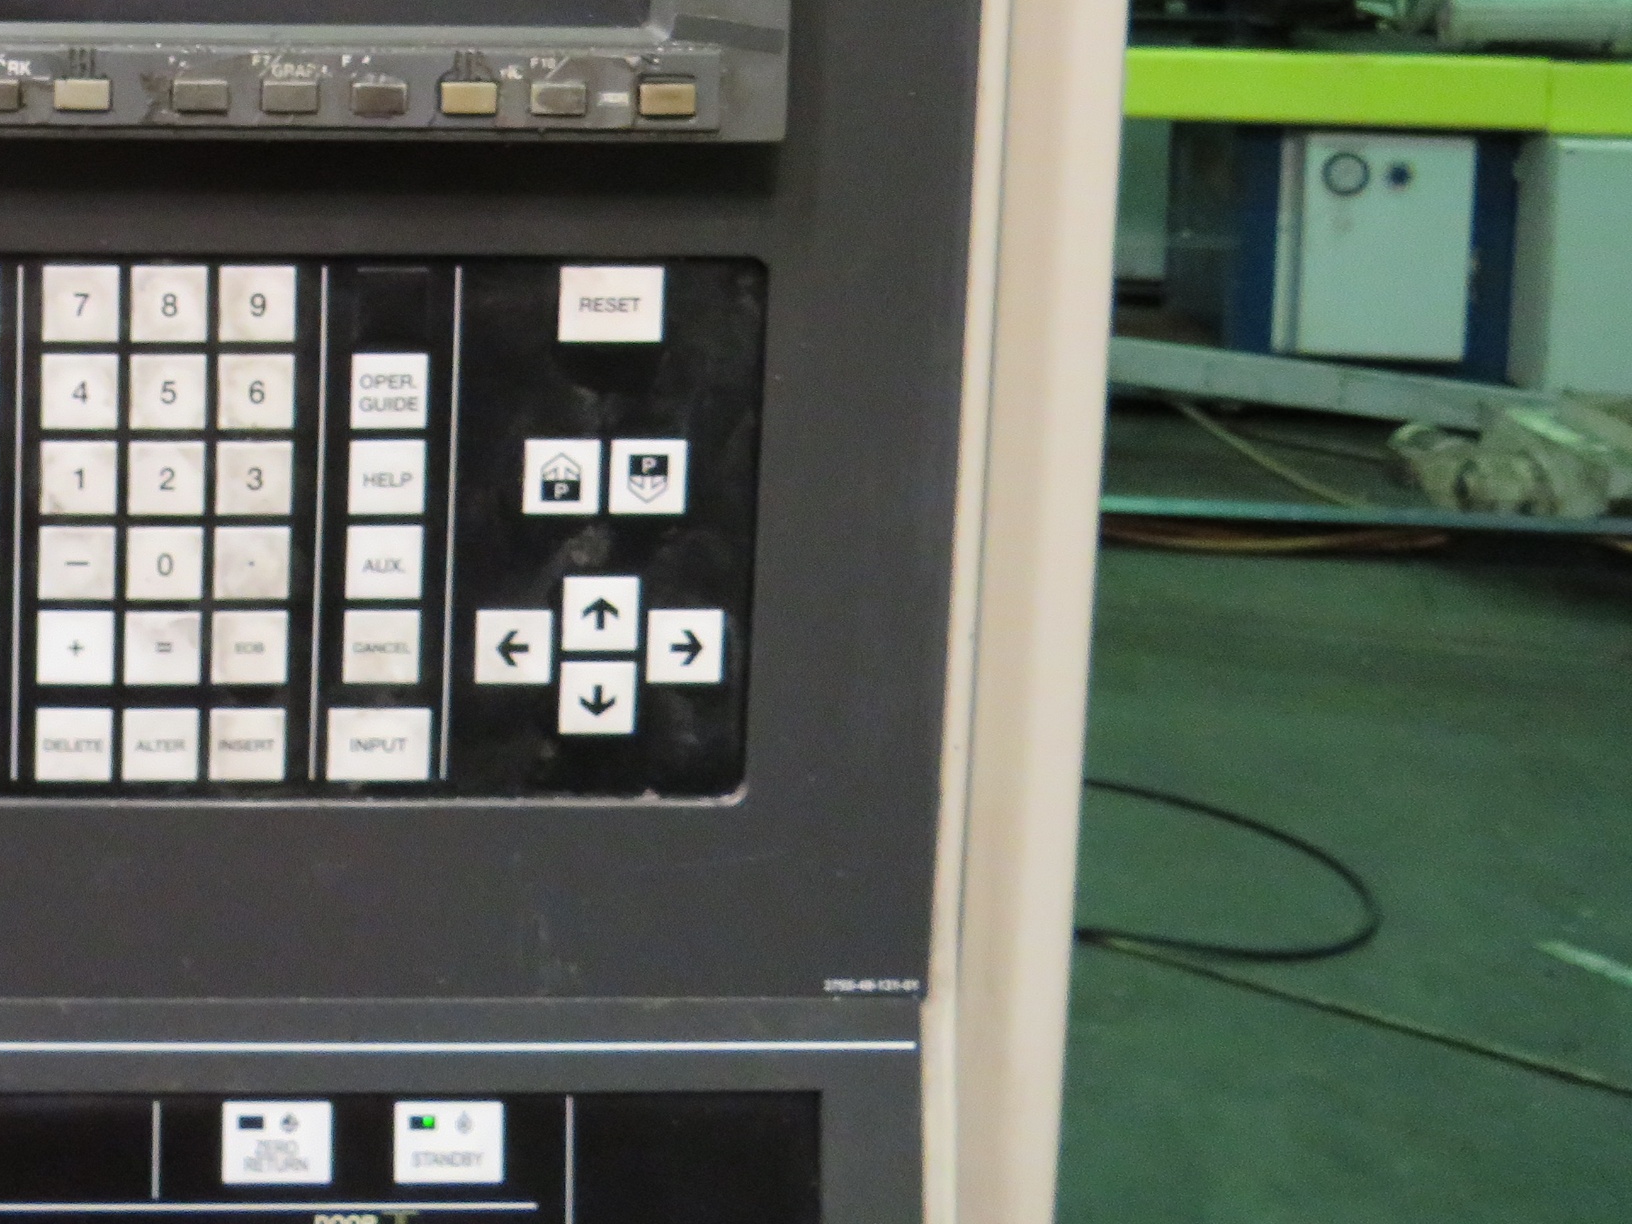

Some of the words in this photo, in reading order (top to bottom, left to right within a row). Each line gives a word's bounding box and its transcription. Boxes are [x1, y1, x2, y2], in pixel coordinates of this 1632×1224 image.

[74, 292, 91, 316] 7
[161, 293, 178, 318] 8
[250, 293, 267, 317] 9
[579, 296, 641, 313] RESET
[72, 381, 89, 403] 4
[161, 380, 177, 404] 5
[248, 380, 265, 404] 6
[359, 397, 419, 412] GUIDE
[74, 468, 85, 490] 1
[159, 467, 176, 491] 2
[246, 466, 264, 491] 3
[363, 472, 413, 488] HELP
[43, 738, 104, 753] DELETE
[135, 739, 186, 752] ALTER
[217, 739, 274, 752] INSERT
[350, 737, 407, 753] INPUT
